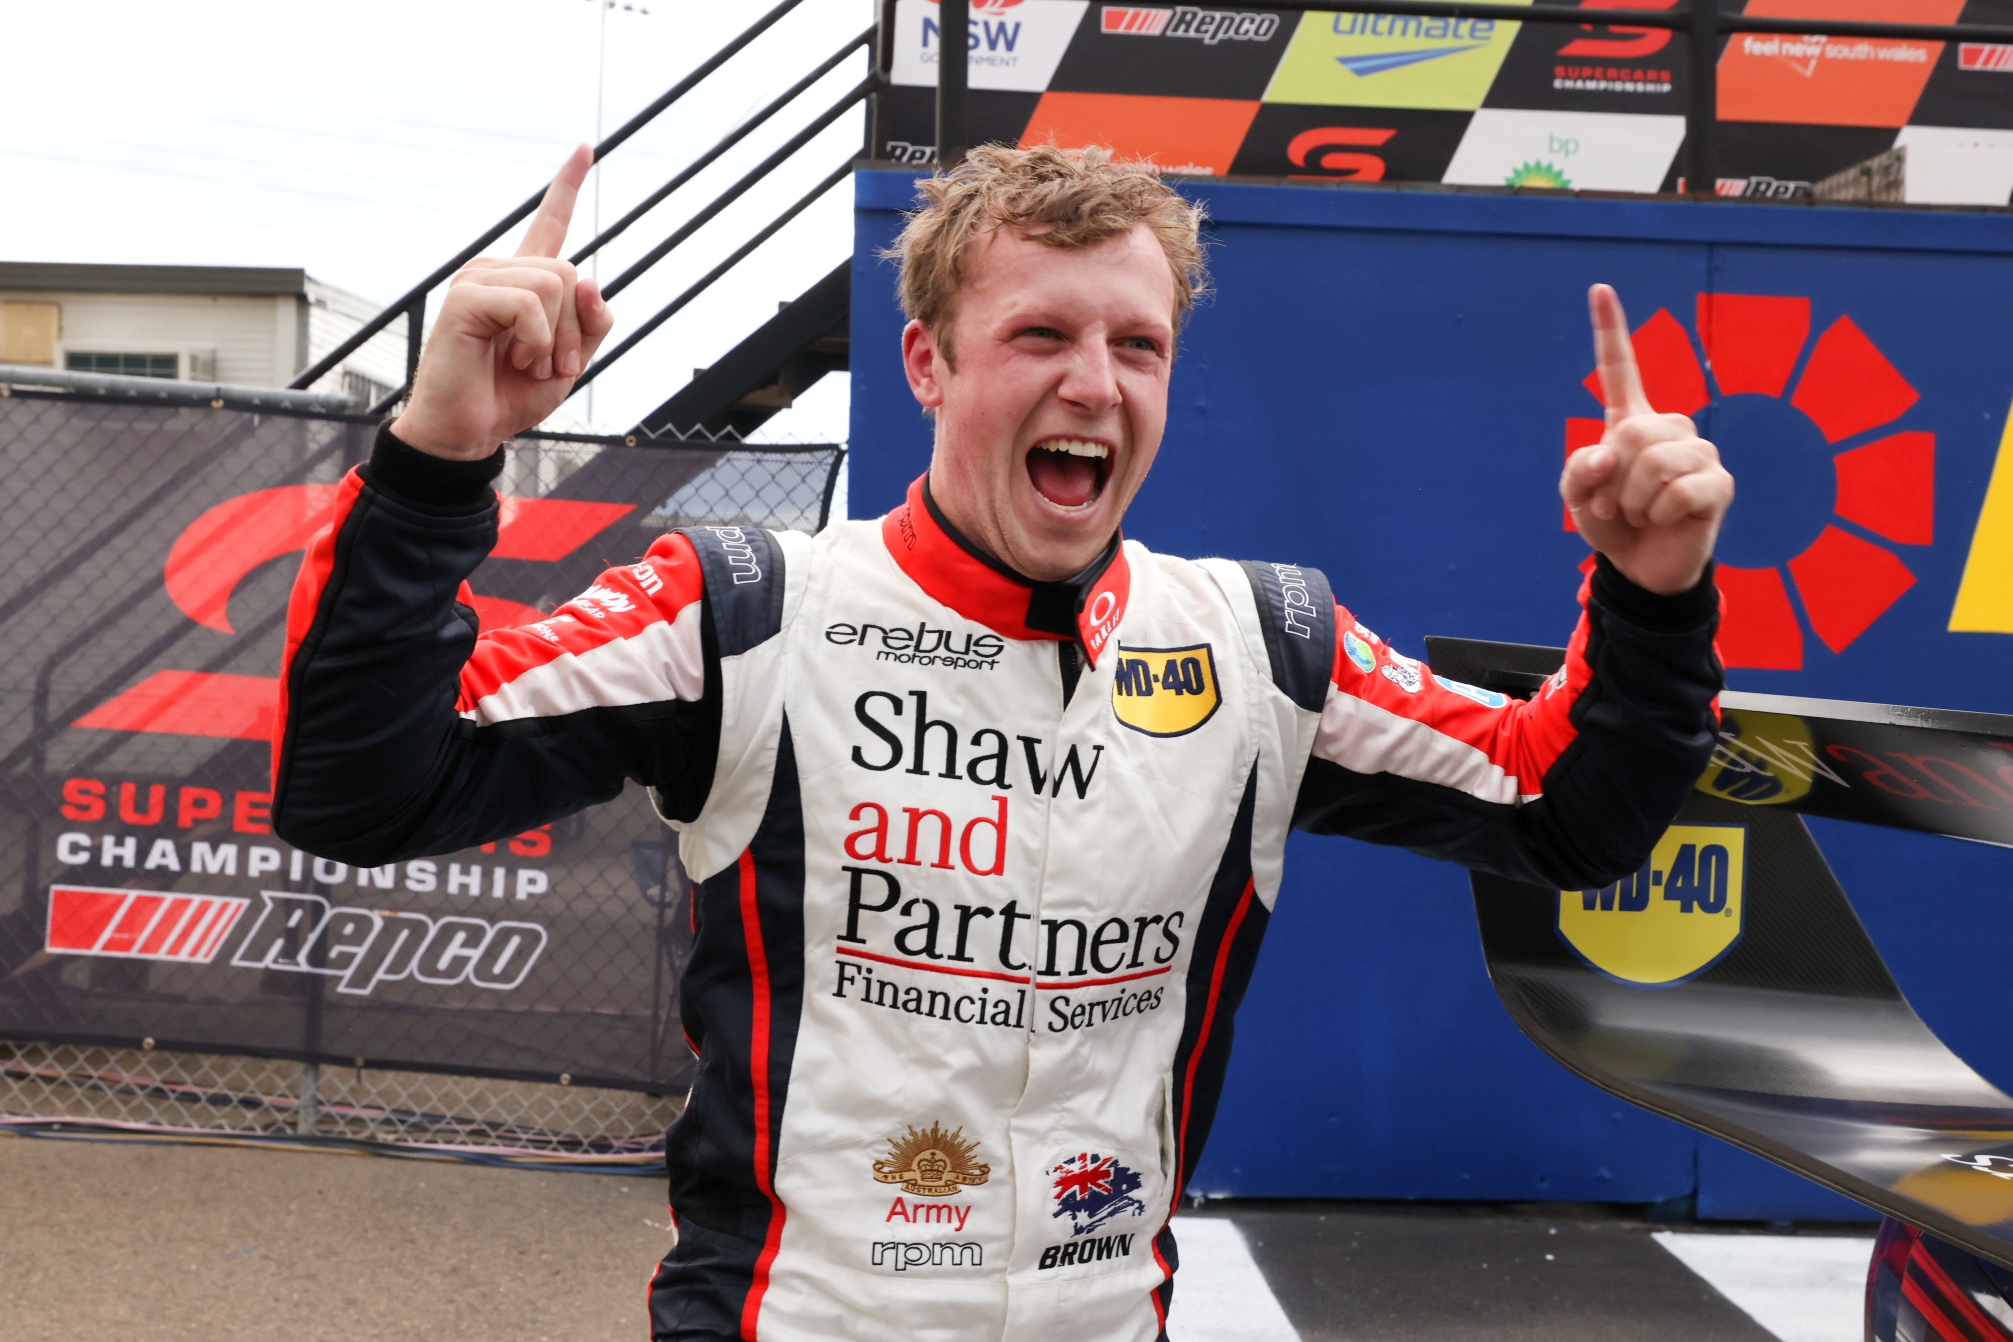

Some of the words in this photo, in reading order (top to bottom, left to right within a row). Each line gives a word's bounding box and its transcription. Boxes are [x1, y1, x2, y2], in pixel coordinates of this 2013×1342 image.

[1167, 6, 1280, 44] Repco
[920, 51, 1019, 67] GONMENT
[1743, 36, 1780, 55] feel
[1781, 41, 1822, 57] new
[1824, 43, 1875, 60] south
[1877, 44, 1928, 63] wales
[1553, 78, 1672, 93] CHAMPIONSHIP
[1554, 65, 1672, 83] SUPERCARS
[1548, 132, 1579, 156] bp
[705, 526, 762, 585] pm
[825, 621, 1005, 658] erebus
[876, 649, 1000, 671] motorsport
[851, 690, 1104, 800] Shaw
[60, 778, 552, 857] SUPES
[843, 795, 1008, 877] and
[56, 832, 549, 900] CHAMPIONSHIP
[836, 866, 1184, 977] Partners
[231, 890, 547, 995] Repco
[832, 960, 1035, 1033] Financial
[1047, 985, 1163, 1033] Services
[885, 1197, 972, 1232] Army
[871, 1241, 983, 1271] rpm
[1037, 1233, 1136, 1271] BROWN
